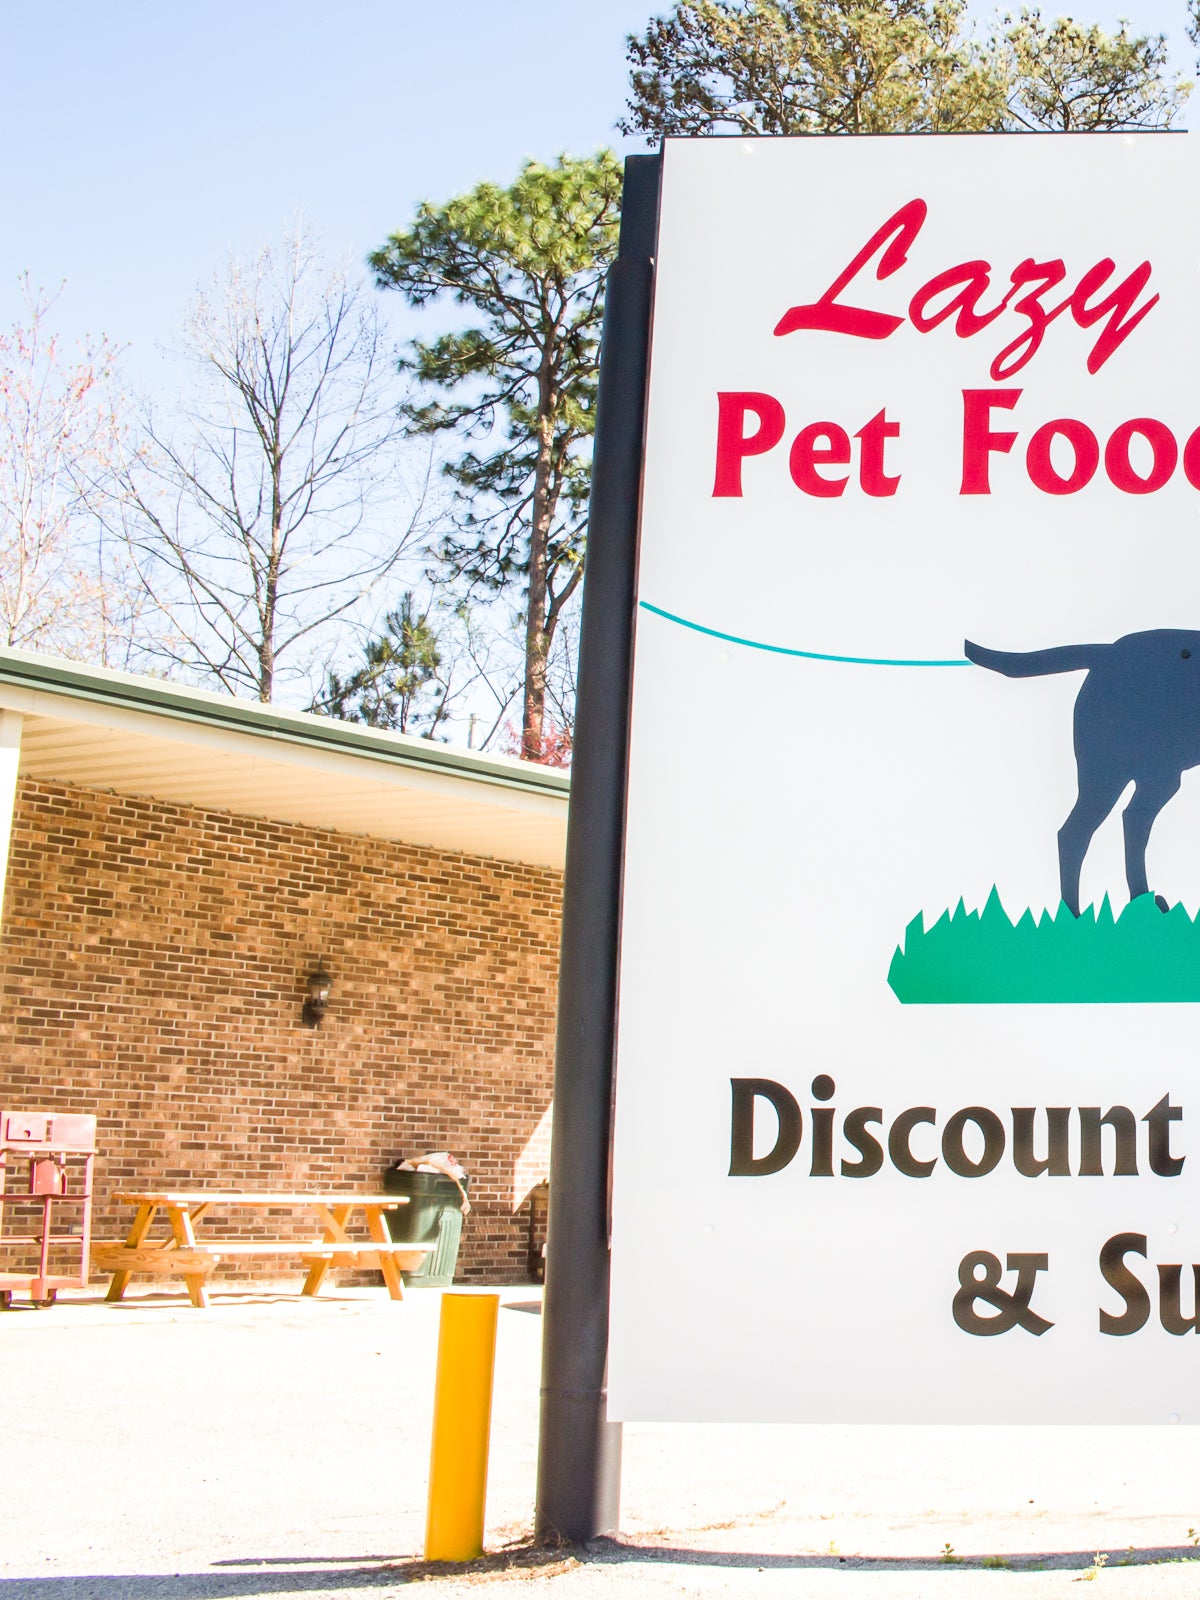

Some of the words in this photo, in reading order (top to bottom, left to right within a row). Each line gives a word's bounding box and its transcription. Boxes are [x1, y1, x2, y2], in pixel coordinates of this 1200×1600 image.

[774, 198, 1160, 380] Lazy
[712, 391, 901, 498] Pet
[728, 1074, 1186, 1178] Discount
[951, 1250, 1056, 1337] &
